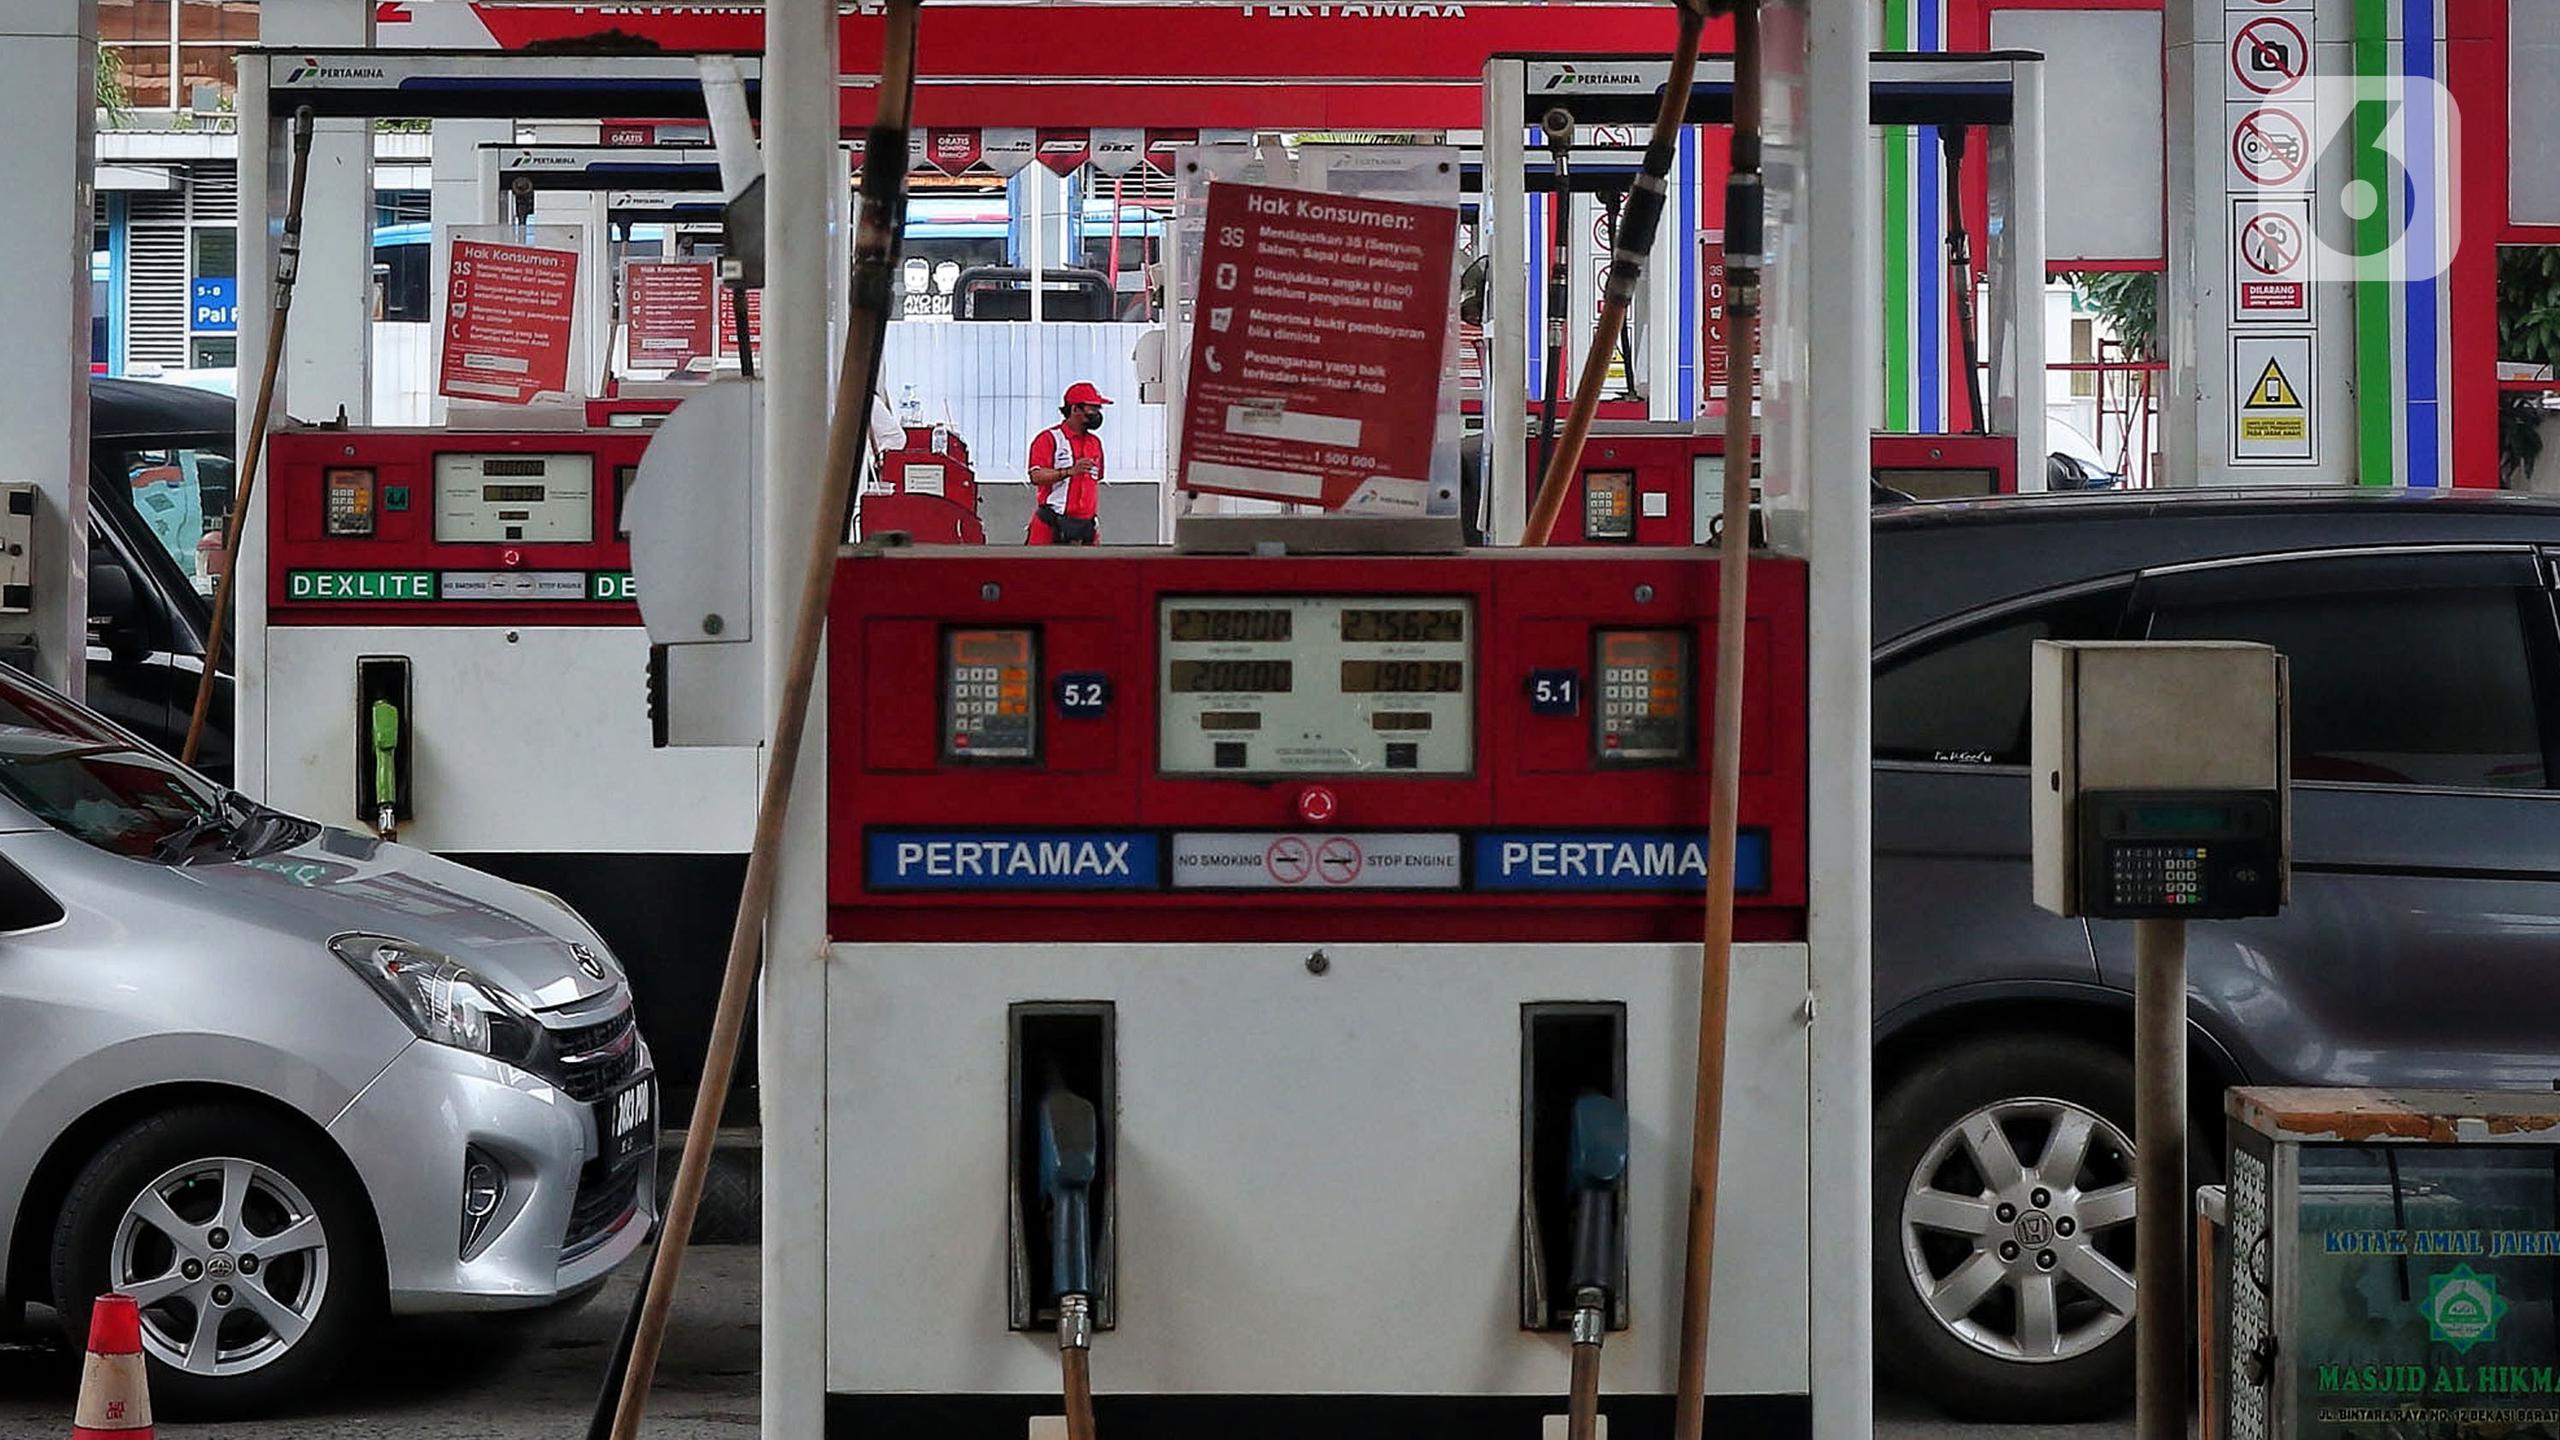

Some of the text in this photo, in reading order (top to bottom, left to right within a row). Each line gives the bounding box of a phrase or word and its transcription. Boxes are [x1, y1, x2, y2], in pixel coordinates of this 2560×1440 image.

[320, 68, 384, 79] PERTAMINA
[1577, 74, 1641, 85] PERTAMINA
[937, 137, 970, 146] GRATIS
[1099, 144, 1136, 152] DEX
[1248, 194, 1415, 230] Hak Konsumen:
[1219, 226, 1245, 248] 3S
[1259, 226, 1343, 246] Mendapatkan
[464, 246, 490, 260] Hak
[492, 248, 558, 268] Konsumen
[1342, 253, 1367, 265] dari
[1368, 254, 1420, 273] petugas
[453, 260, 471, 276] 3S
[1252, 284, 1306, 301] sebelum
[1332, 278, 1371, 295] angka
[2249, 285, 2296, 295] DILARANG
[1248, 324, 1321, 344] bila diminta
[1249, 308, 1426, 341] Menerima bukti pembayaran
[1244, 349, 1386, 378] Penanganan yang baik
[1353, 379, 1387, 395] Anda
[293, 575, 429, 596] DEXLITE
[597, 576, 637, 597] DE
[1064, 683, 1102, 707] 5.2
[1535, 679, 1571, 703] 5.1
[898, 841, 1130, 876] PERTAMAX
[1178, 854, 1455, 867] NO SMOKING STOP ENGINE
[1502, 842, 1708, 876] PERTAMA
[2324, 1229, 2408, 1255] KOTAK
[2413, 1229, 2484, 1255] AMAL
[2318, 1365, 2427, 1392] MASJID
[2432, 1366, 2471, 1393] AL
[2394, 1409, 2428, 1422] RAYA
[2430, 1410, 2450, 1422] NO.
[2455, 1409, 2469, 1422] 12
[2470, 1409, 2515, 1422] BEKASI
[2517, 1409, 2560, 1422] BARAT
